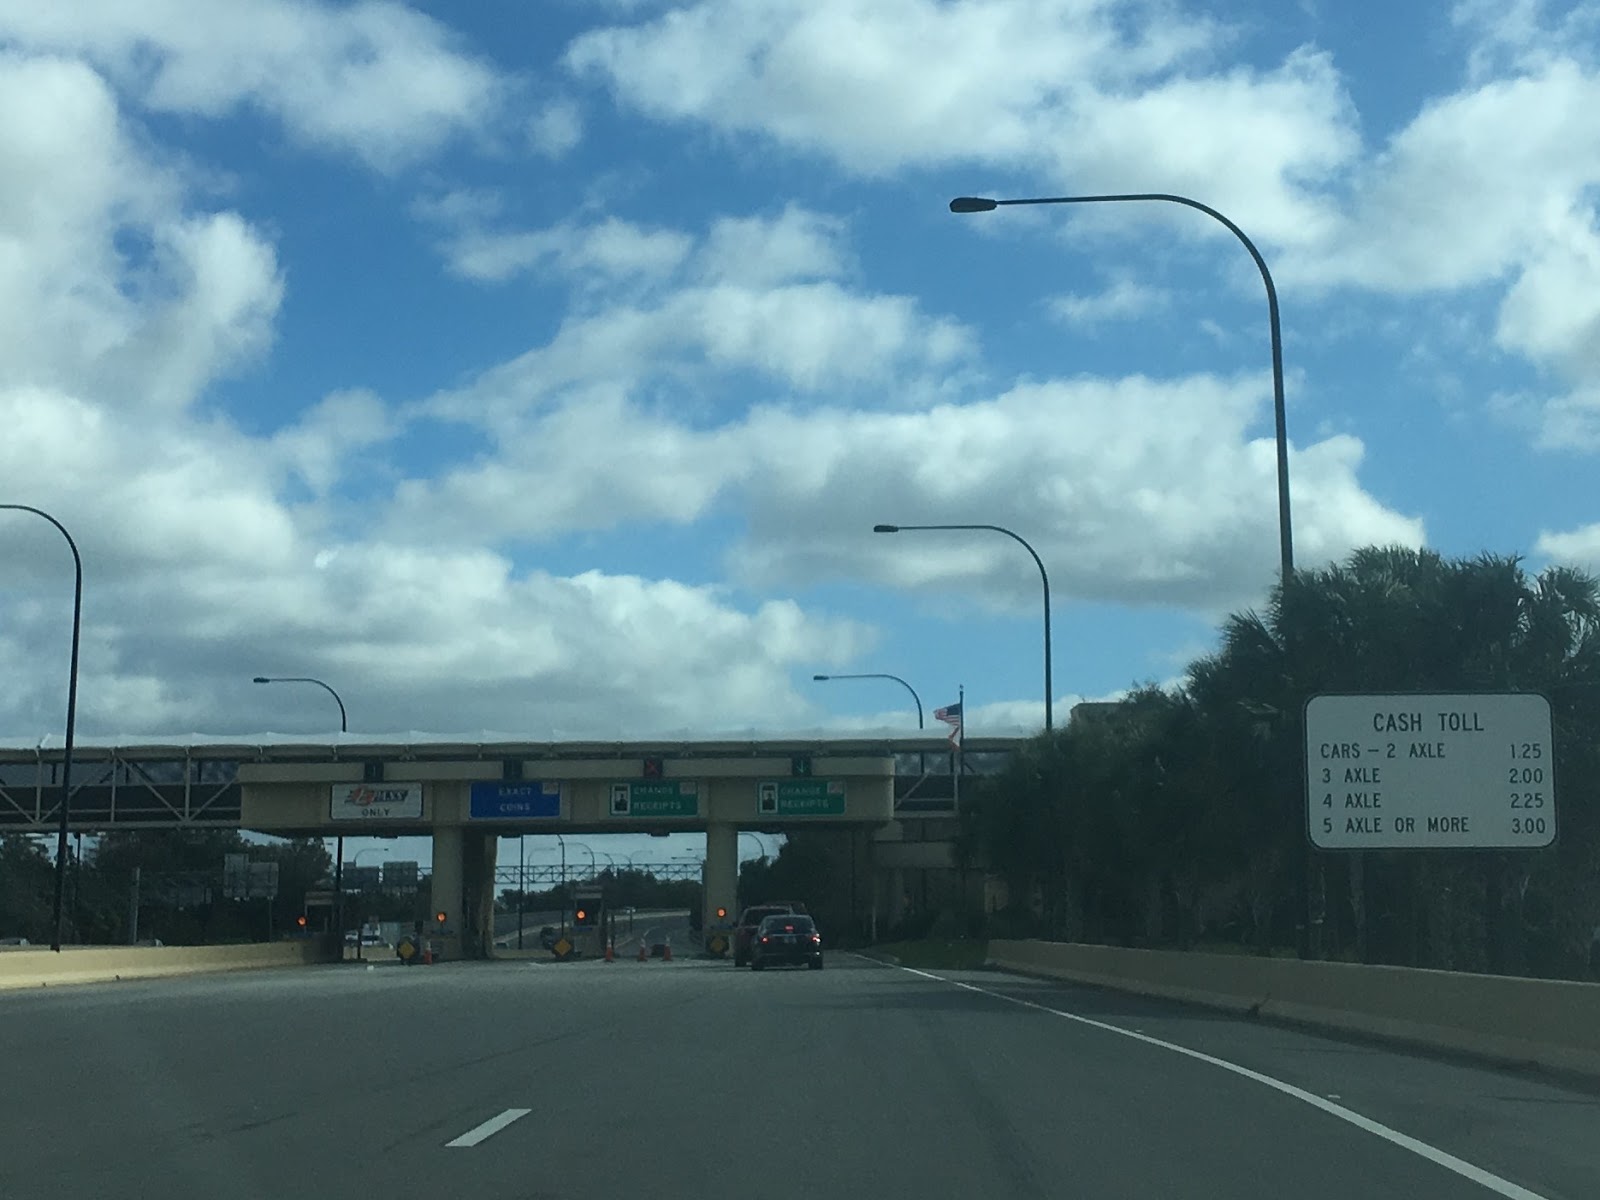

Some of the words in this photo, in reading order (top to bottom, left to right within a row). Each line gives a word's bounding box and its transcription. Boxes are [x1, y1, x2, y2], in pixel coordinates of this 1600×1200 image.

[1374, 713, 1422, 732] CASH
[1438, 713, 1484, 732] TOLL
[1321, 743, 1360, 758] CARS
[1387, 743, 1396, 758] 2
[1409, 743, 1446, 758] AXLE
[1509, 744, 1541, 759] 1.25
[1322, 768, 1331, 783] 3
[1344, 768, 1381, 783] AXLE
[1509, 768, 1543, 784] 2.00
[499, 787, 532, 795] EXACT
[499, 802, 530, 812] COINS
[1323, 794, 1332, 808] 4
[1345, 793, 1381, 808] AXLE
[1510, 793, 1544, 808] 2.25
[361, 808, 389, 816] ONLY
[1323, 818, 1332, 833] 5
[1345, 818, 1382, 833] AXLE
[1395, 817, 1415, 833] OR
[1427, 817, 1470, 833] MORE
[1512, 818, 1546, 834] 3.00
